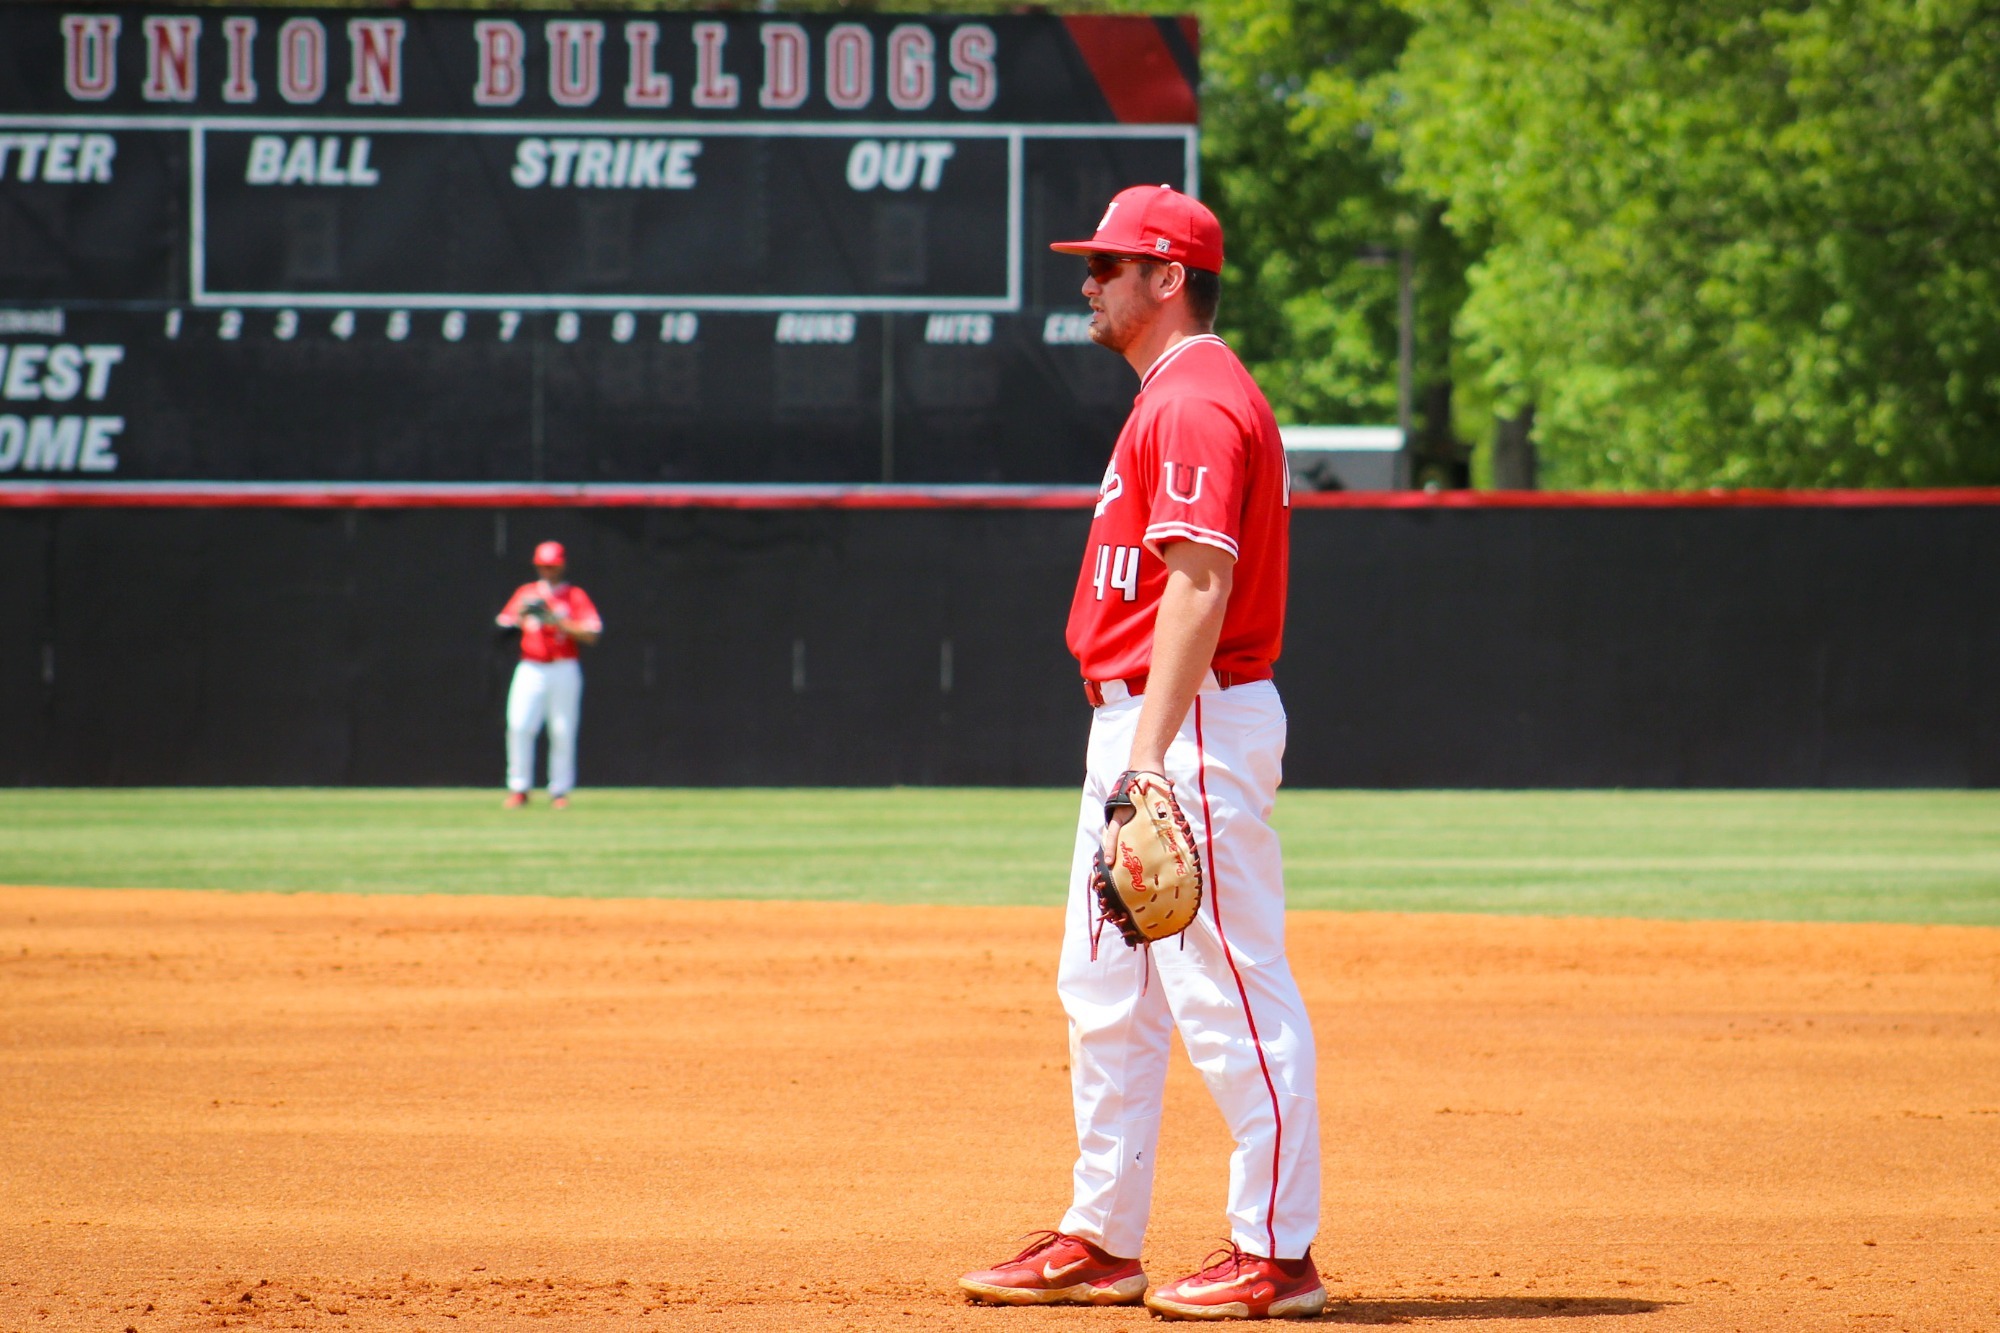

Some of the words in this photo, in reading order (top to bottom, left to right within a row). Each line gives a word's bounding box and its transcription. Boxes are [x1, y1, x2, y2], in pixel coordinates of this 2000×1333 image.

[61, 15, 404, 104] UNION
[474, 20, 998, 110] BULLDOGS
[246, 136, 379, 186] BALL
[512, 139, 702, 188] STRIKE
[847, 140, 954, 190] OUT
[166, 310, 182, 339] 1
[218, 310, 243, 339] 2
[274, 310, 298, 340] 3
[331, 310, 355, 340] 4
[387, 310, 409, 341] 5
[442, 311, 466, 341] 6
[499, 311, 521, 342] 7
[556, 312, 580, 343] 8
[612, 312, 636, 343] 9
[660, 312, 698, 343] 10
[775, 313, 856, 343] RUNS
[924, 314, 993, 343] HITS
[1163, 461, 1208, 504] U
[1092, 544, 1141, 601] 44
